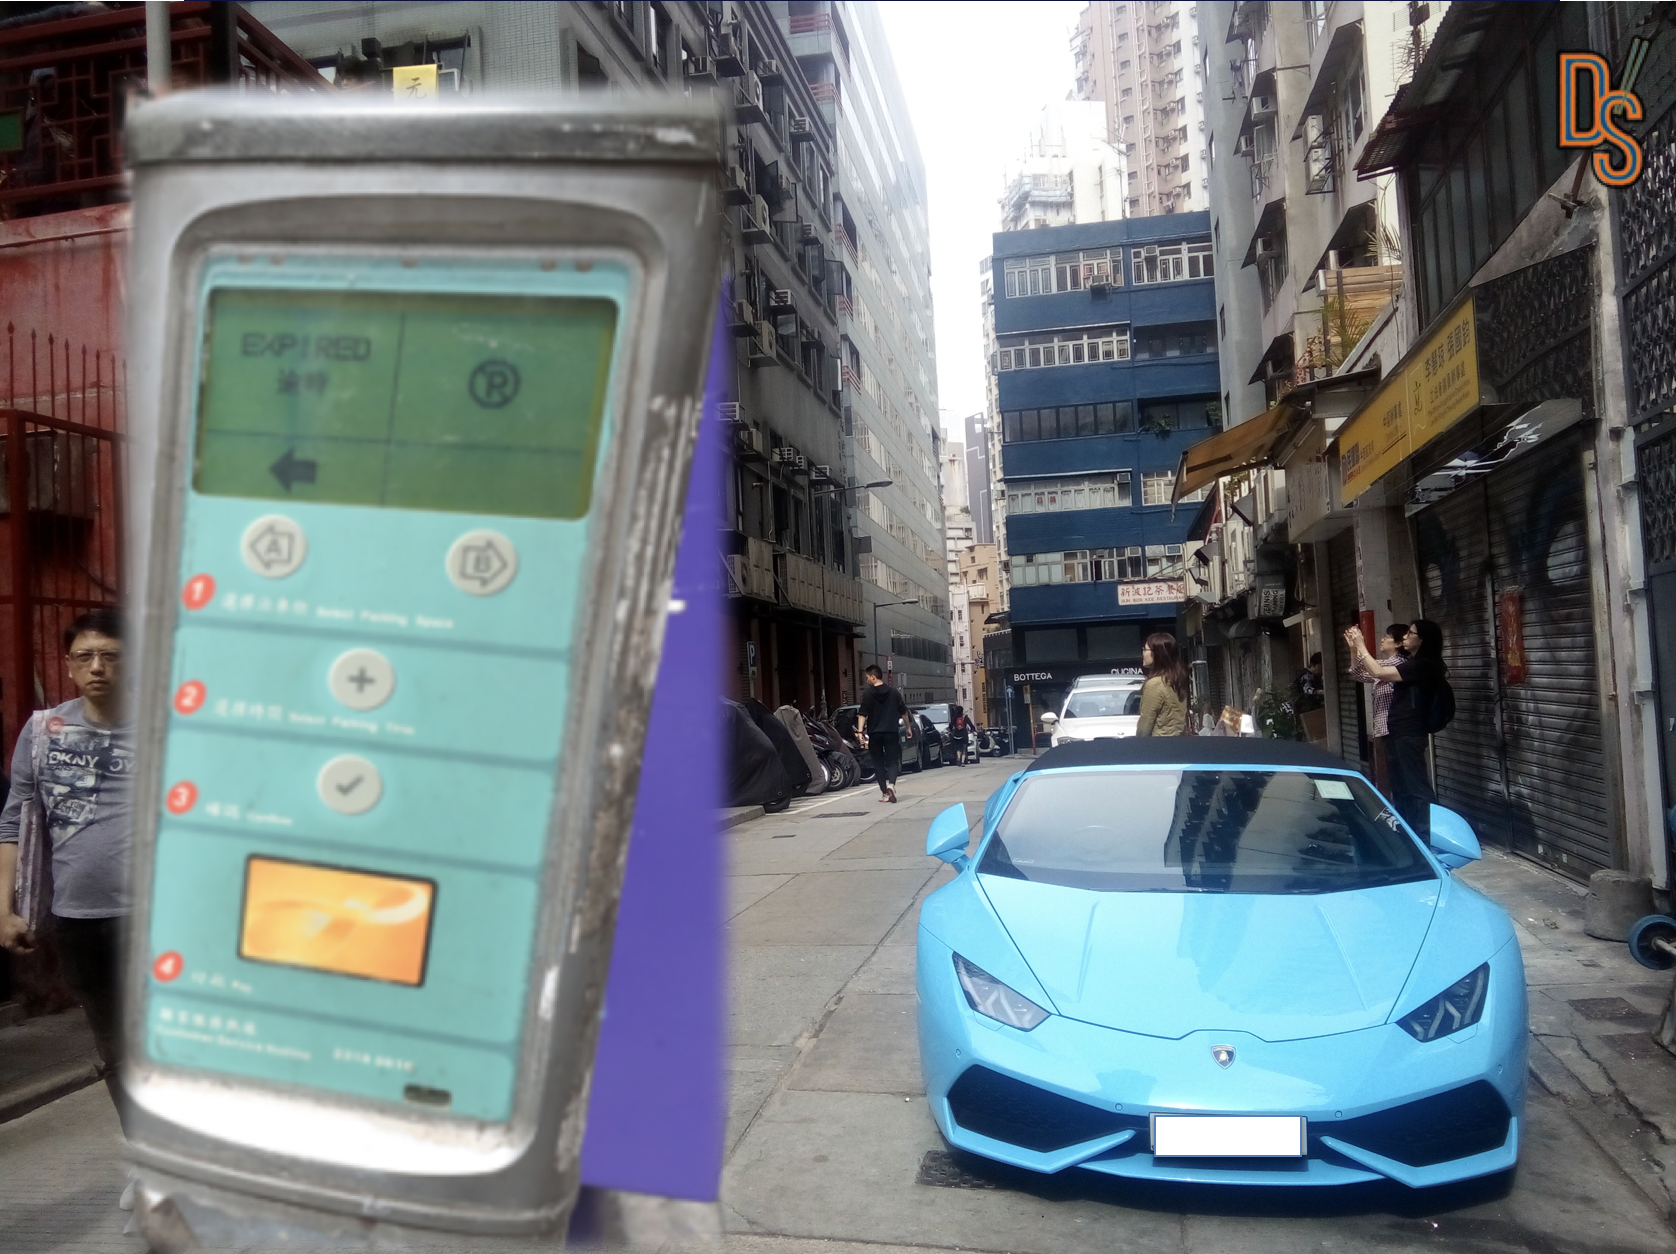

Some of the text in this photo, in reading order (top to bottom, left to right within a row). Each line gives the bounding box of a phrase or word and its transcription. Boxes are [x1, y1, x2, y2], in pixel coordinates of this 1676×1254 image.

[242, 332, 372, 361] EXPIRED
[265, 538, 283, 556] A
[192, 580, 204, 600] 1
[750, 644, 756, 665] P
[1013, 672, 1053, 682] BOTTEGA
[1110, 667, 1144, 676] CUCINA
[181, 685, 198, 707] 2
[48, 751, 99, 769] DKNY
[173, 786, 190, 808] 3
[159, 956, 173, 976] 4
